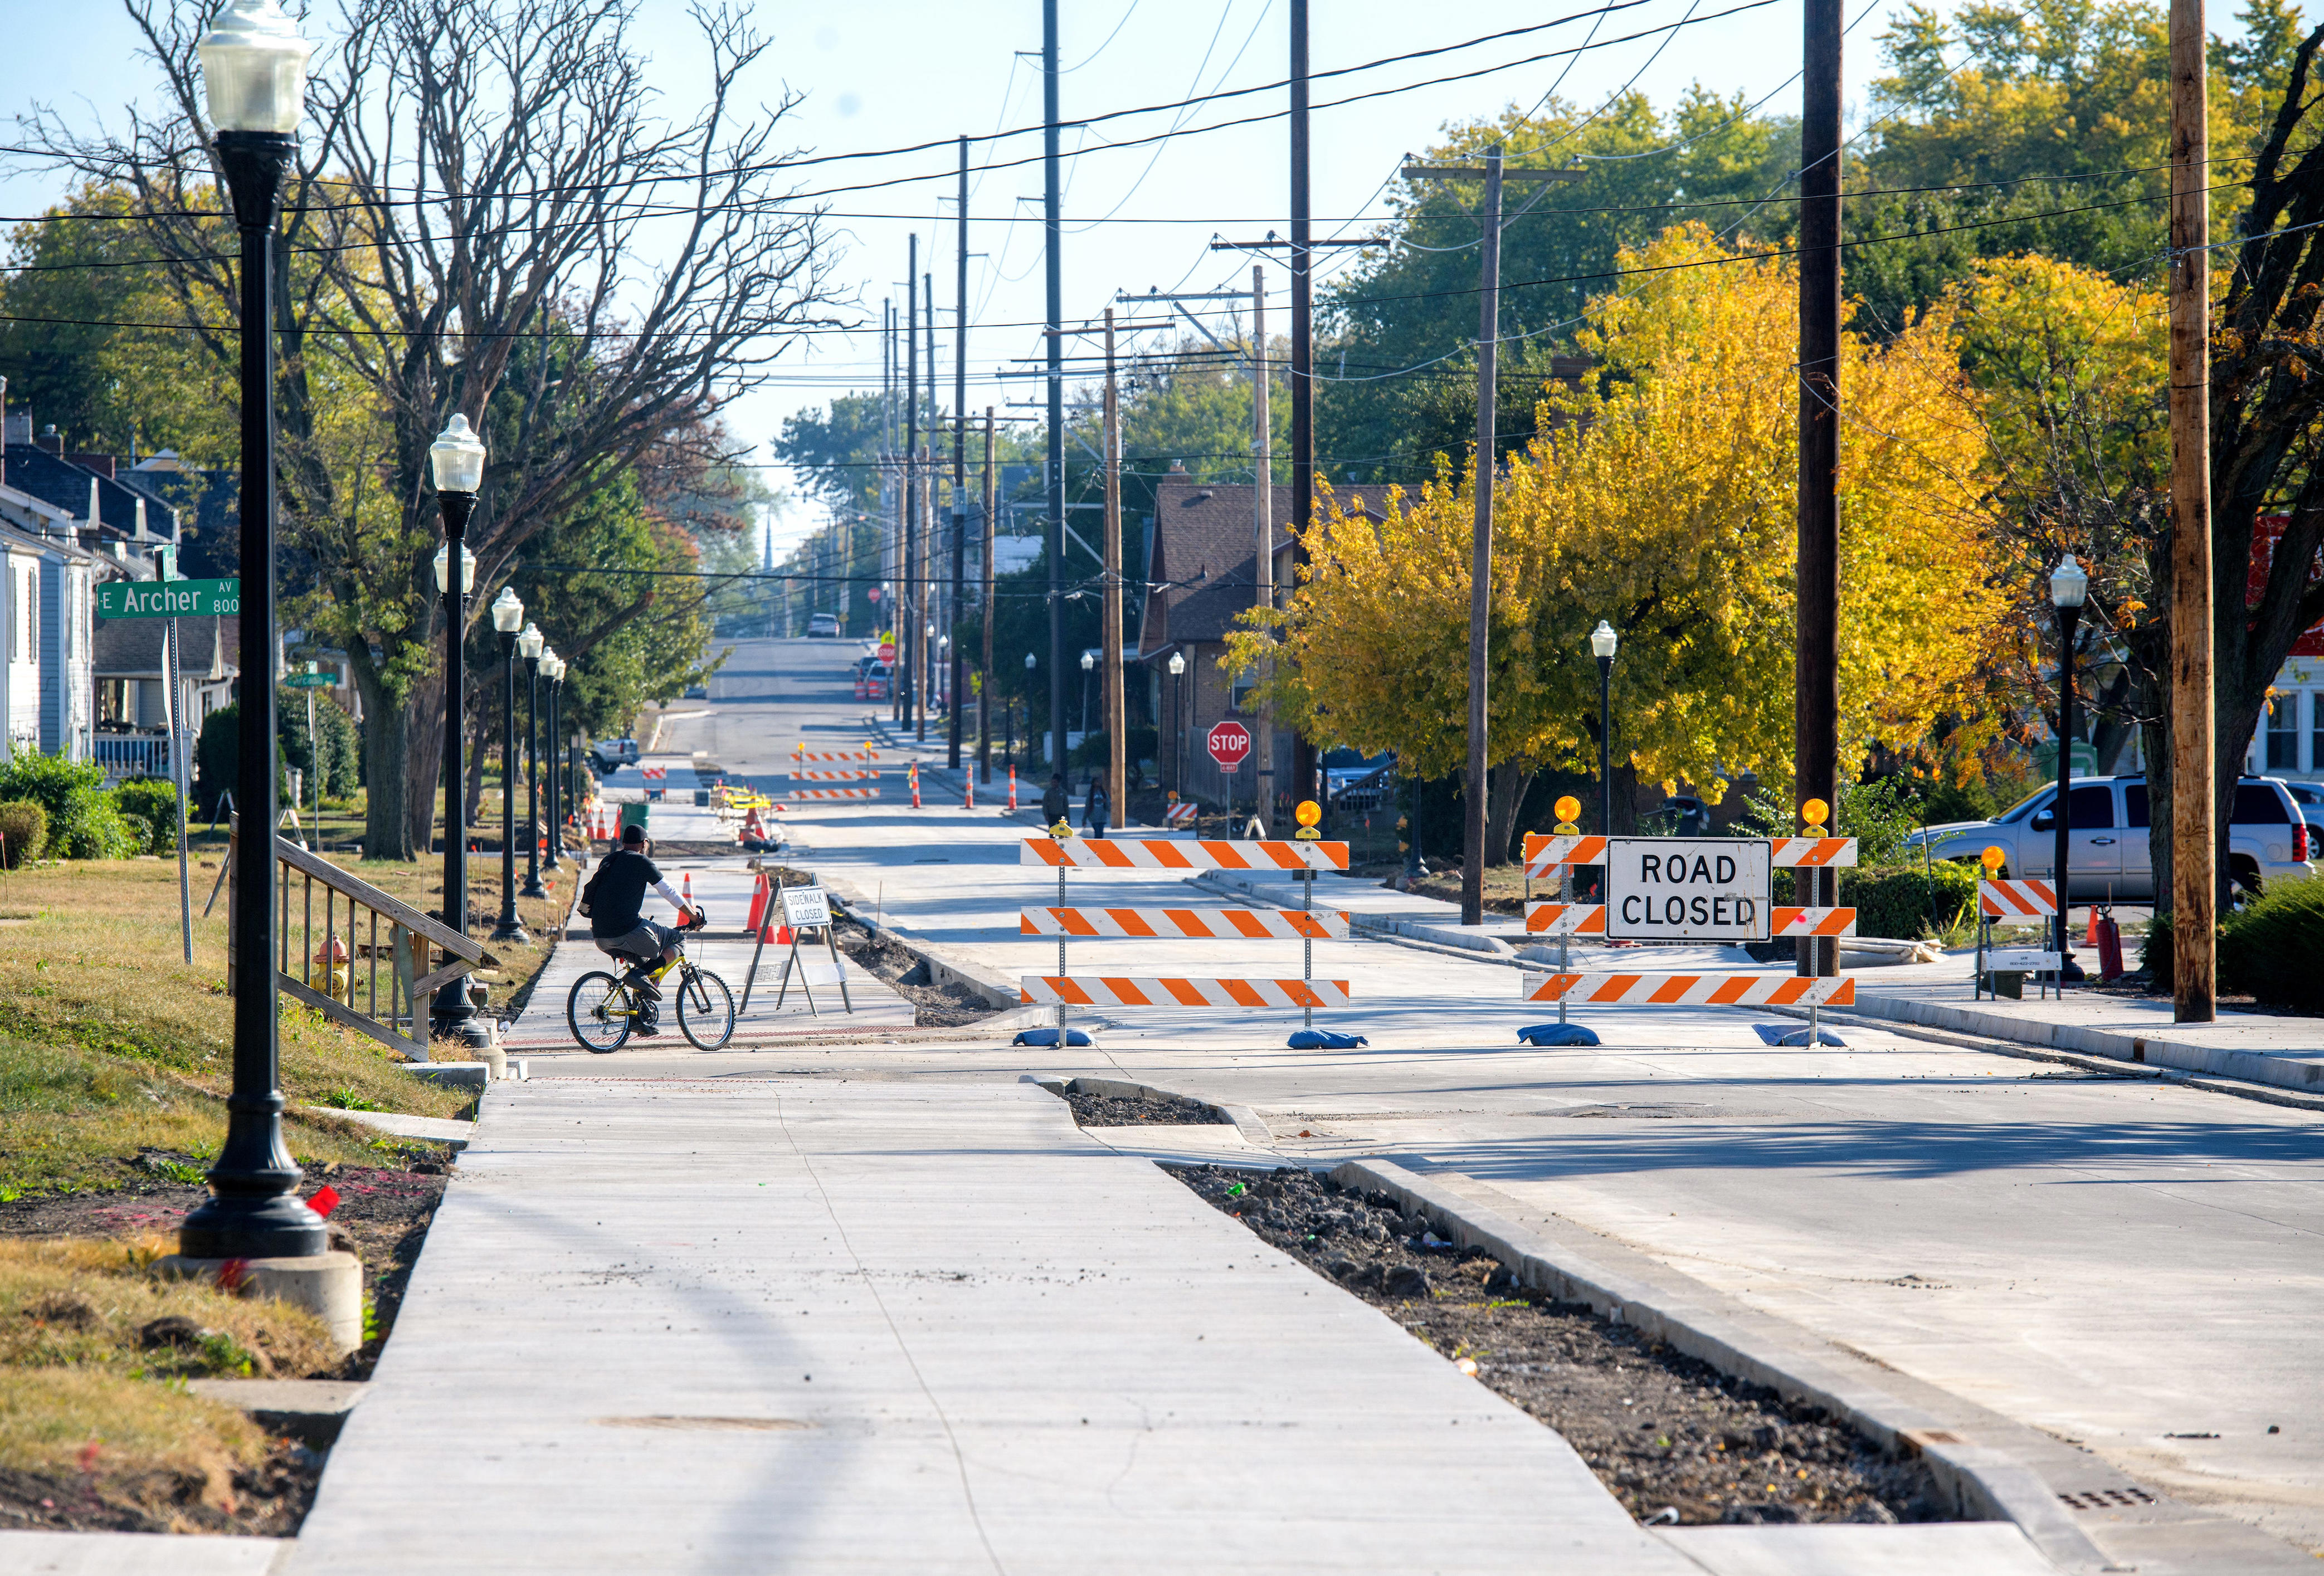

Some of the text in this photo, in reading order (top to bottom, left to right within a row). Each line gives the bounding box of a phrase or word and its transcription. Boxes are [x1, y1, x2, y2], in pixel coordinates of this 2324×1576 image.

[219, 582, 232, 593] AV
[103, 587, 201, 612] E Archer
[213, 599, 239, 613] 800
[1211, 734, 1248, 751] STOP
[1642, 854, 1736, 884] ROAD
[788, 893, 823, 906] SIDEWALK
[796, 908, 823, 920] CLOSED
[1622, 895, 1755, 925] CLOSED
